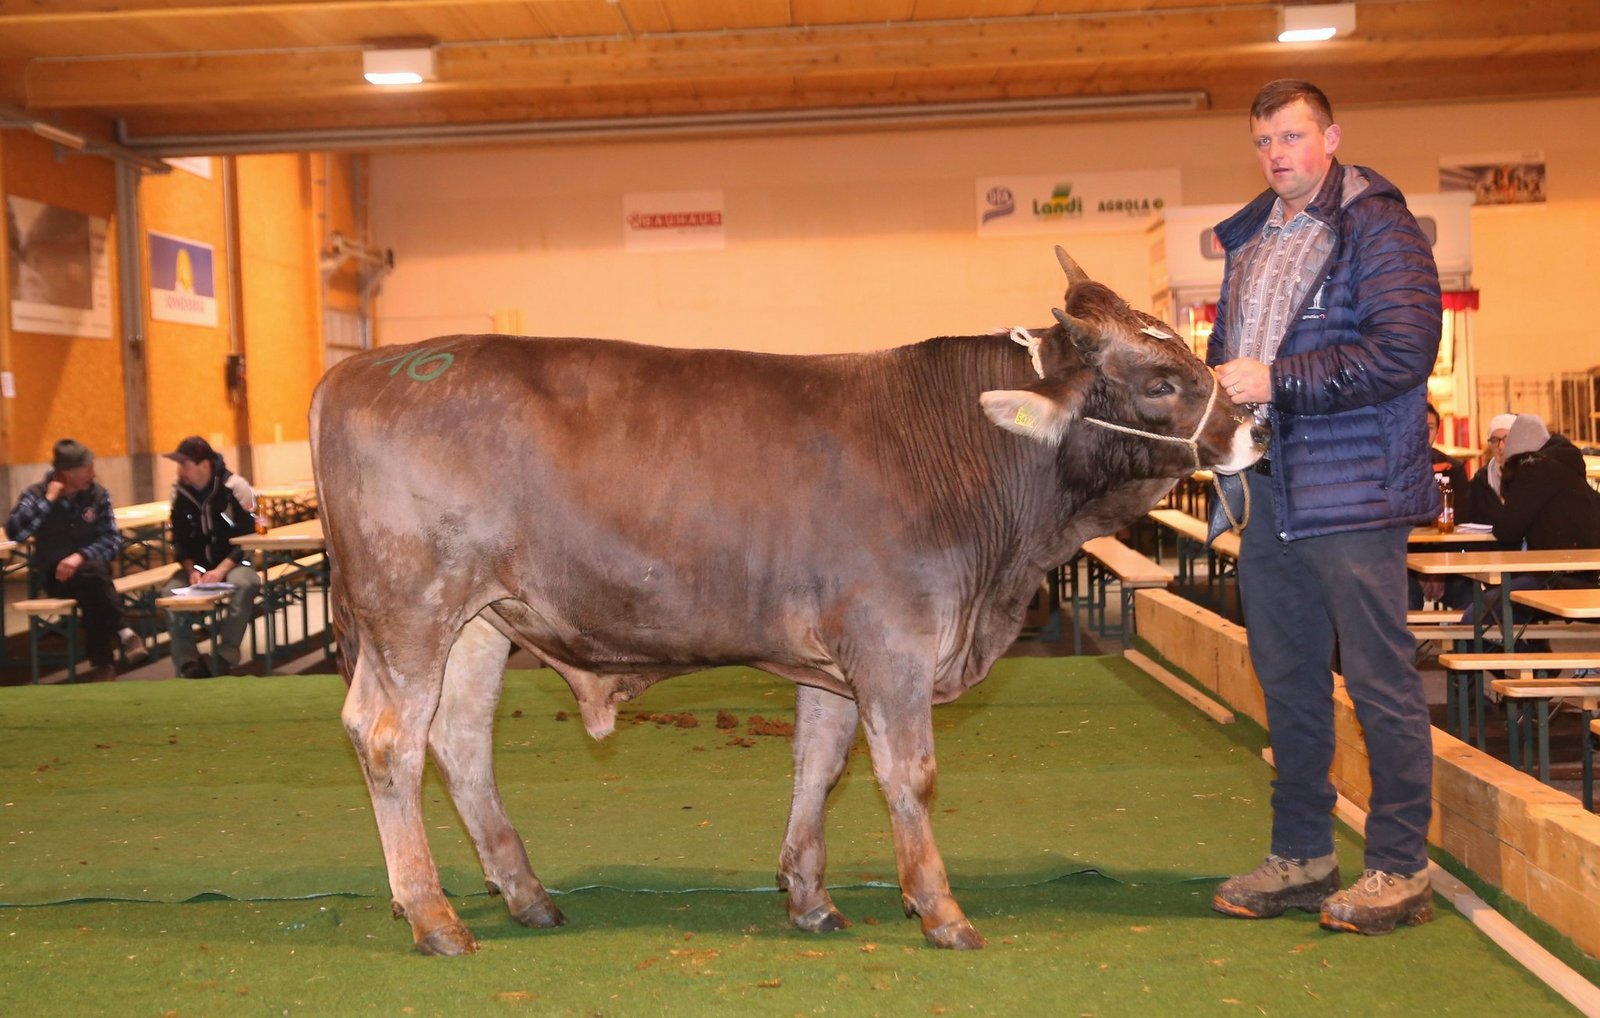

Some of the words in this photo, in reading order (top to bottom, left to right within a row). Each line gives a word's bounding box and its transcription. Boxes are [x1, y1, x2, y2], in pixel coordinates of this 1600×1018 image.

[1032, 197, 1083, 216] Landi
[1097, 198, 1151, 213] AGROLA
[640, 212, 721, 229] BAUHAUS
